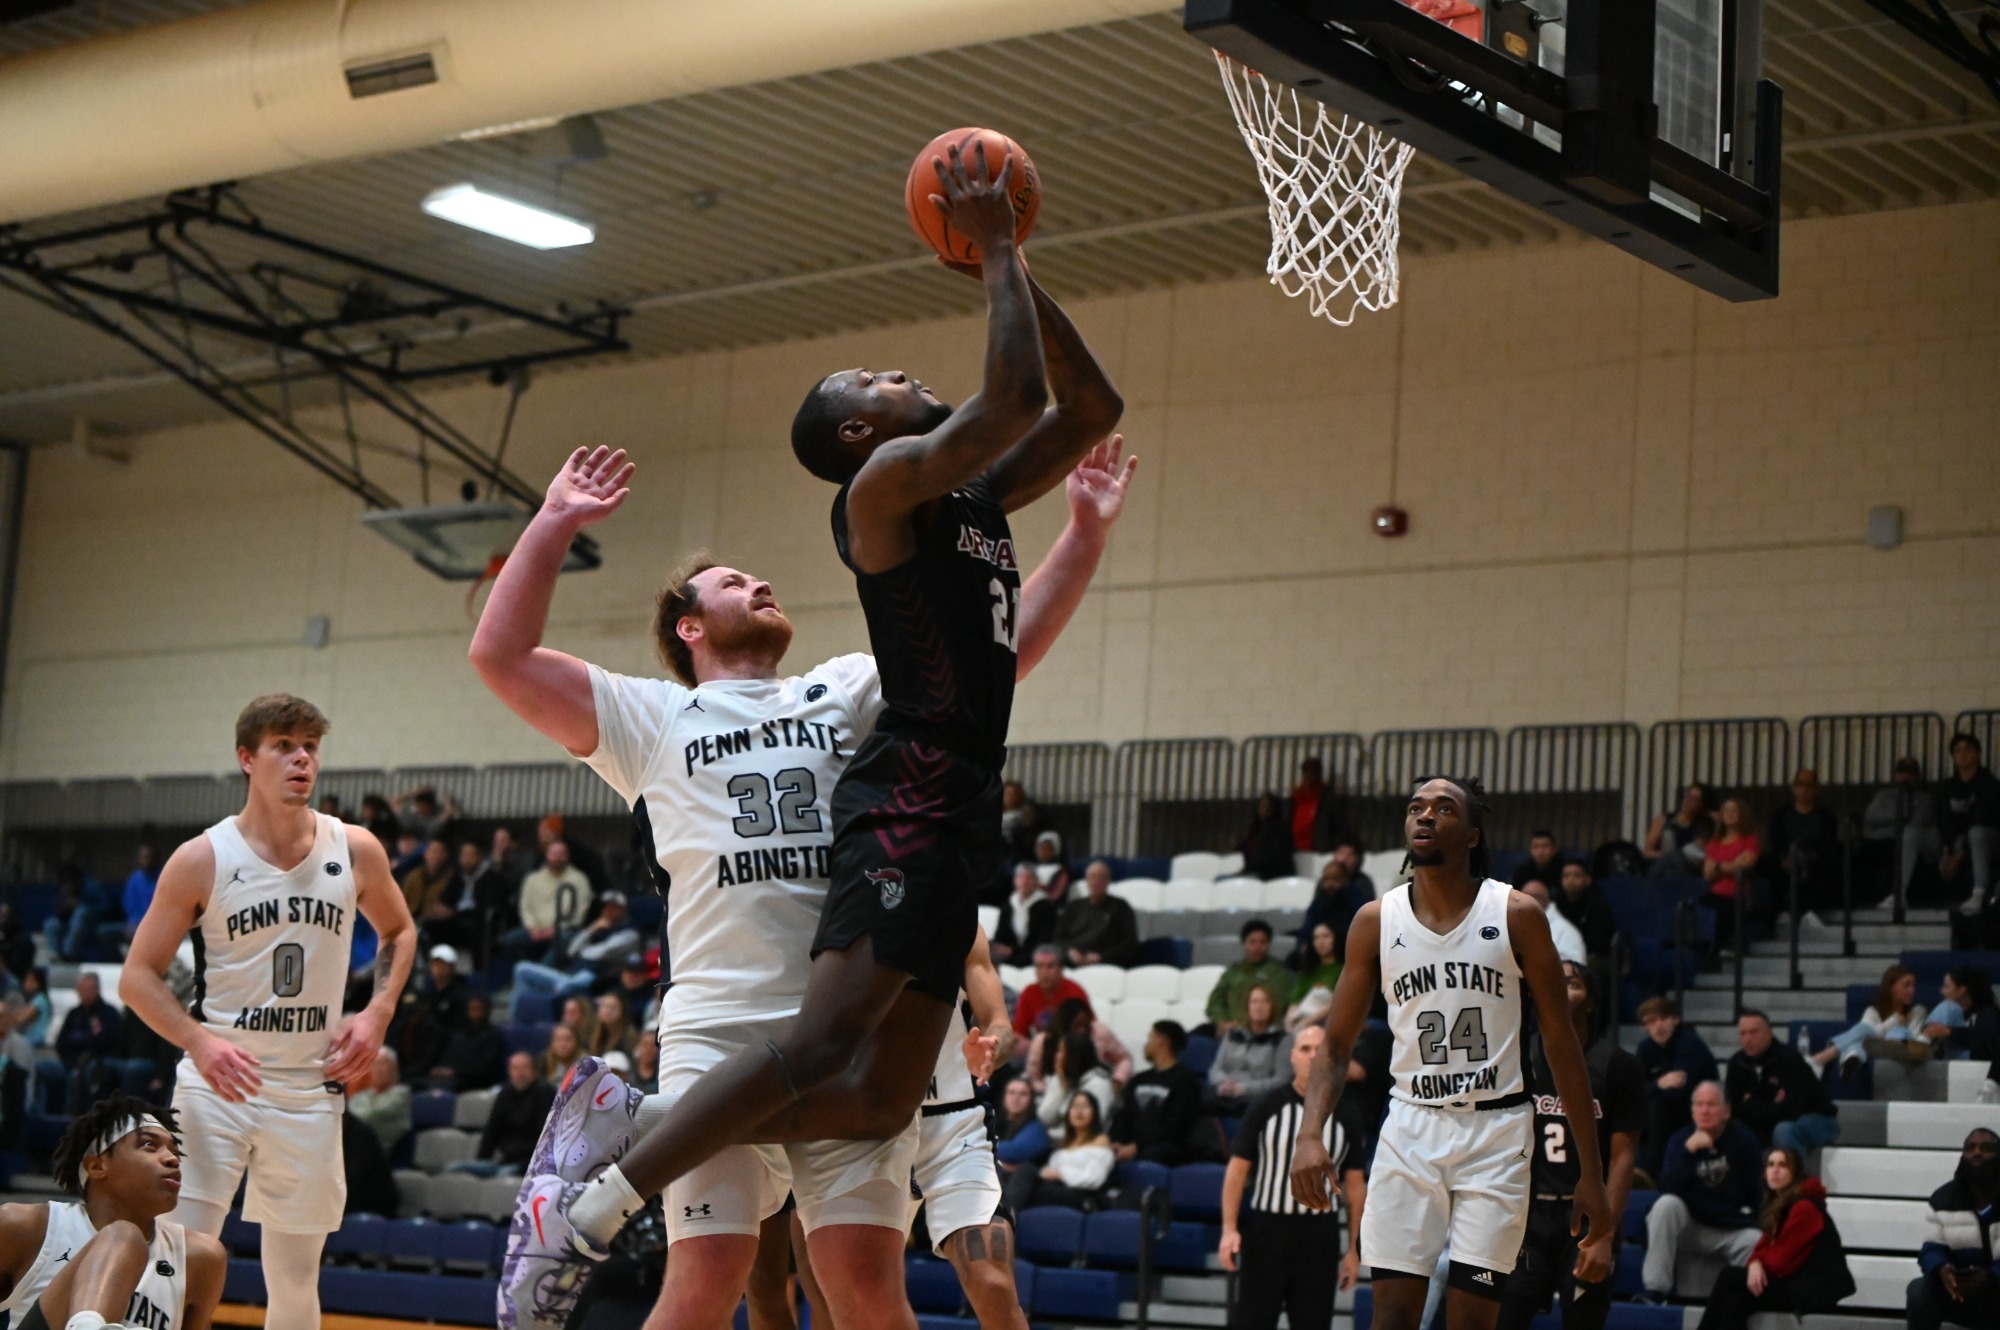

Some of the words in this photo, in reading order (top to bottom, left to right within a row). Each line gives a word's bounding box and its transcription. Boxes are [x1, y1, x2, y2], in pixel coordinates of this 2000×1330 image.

[684, 728, 752, 778] PENN
[761, 717, 844, 761] STATE
[726, 767, 823, 839] 32
[717, 845, 832, 889] ABINGTO
[226, 898, 280, 942] PENN
[287, 896, 345, 936] STATE
[272, 943, 304, 998] 0
[1393, 963, 1437, 1008] PENN
[1444, 961, 1505, 999] STATE
[233, 1005, 329, 1033] ABINGTON
[1416, 1006, 1488, 1065] 24
[1411, 1065, 1499, 1100] ABINGTON
[1543, 1122, 1567, 1163] 2
[125, 1292, 170, 1330] TATE
